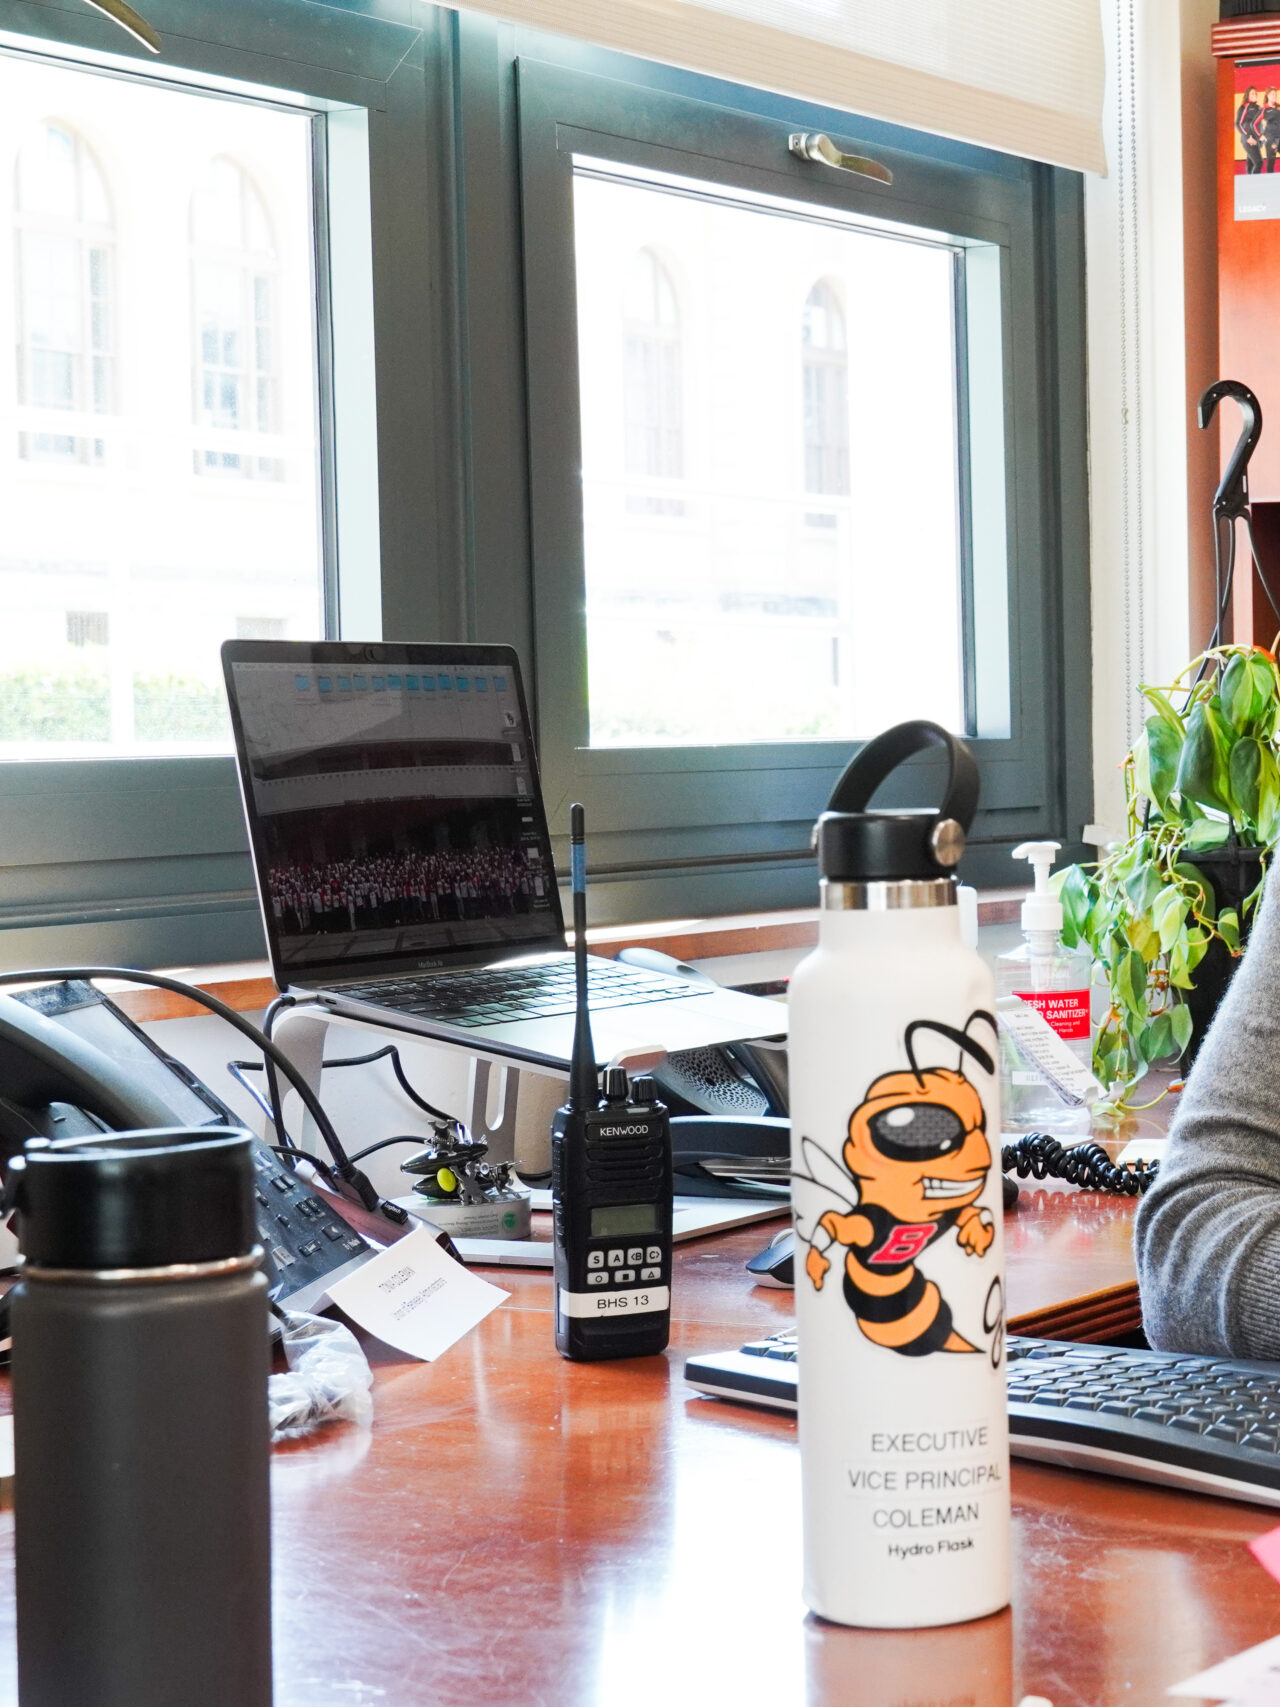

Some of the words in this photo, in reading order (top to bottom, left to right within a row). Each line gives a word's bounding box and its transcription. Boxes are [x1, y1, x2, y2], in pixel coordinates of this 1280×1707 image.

[1048, 998, 1079, 1009] WATER
[1051, 1020, 1072, 1028] Cleaning
[600, 1125, 649, 1137] KENWOOD
[868, 1223, 938, 1264] B
[593, 1255, 600, 1265] S
[613, 1254, 621, 1263] A
[597, 1297, 628, 1310] BHS
[633, 1294, 650, 1307] 13
[872, 1426, 989, 1452] EXECUTIVE
[848, 1469, 897, 1491] VICE
[905, 1463, 1002, 1491] PRINCIPAL
[872, 1503, 980, 1529] COLEMAN
[888, 1542, 935, 1560] Hydro
[938, 1537, 975, 1553] Flask
